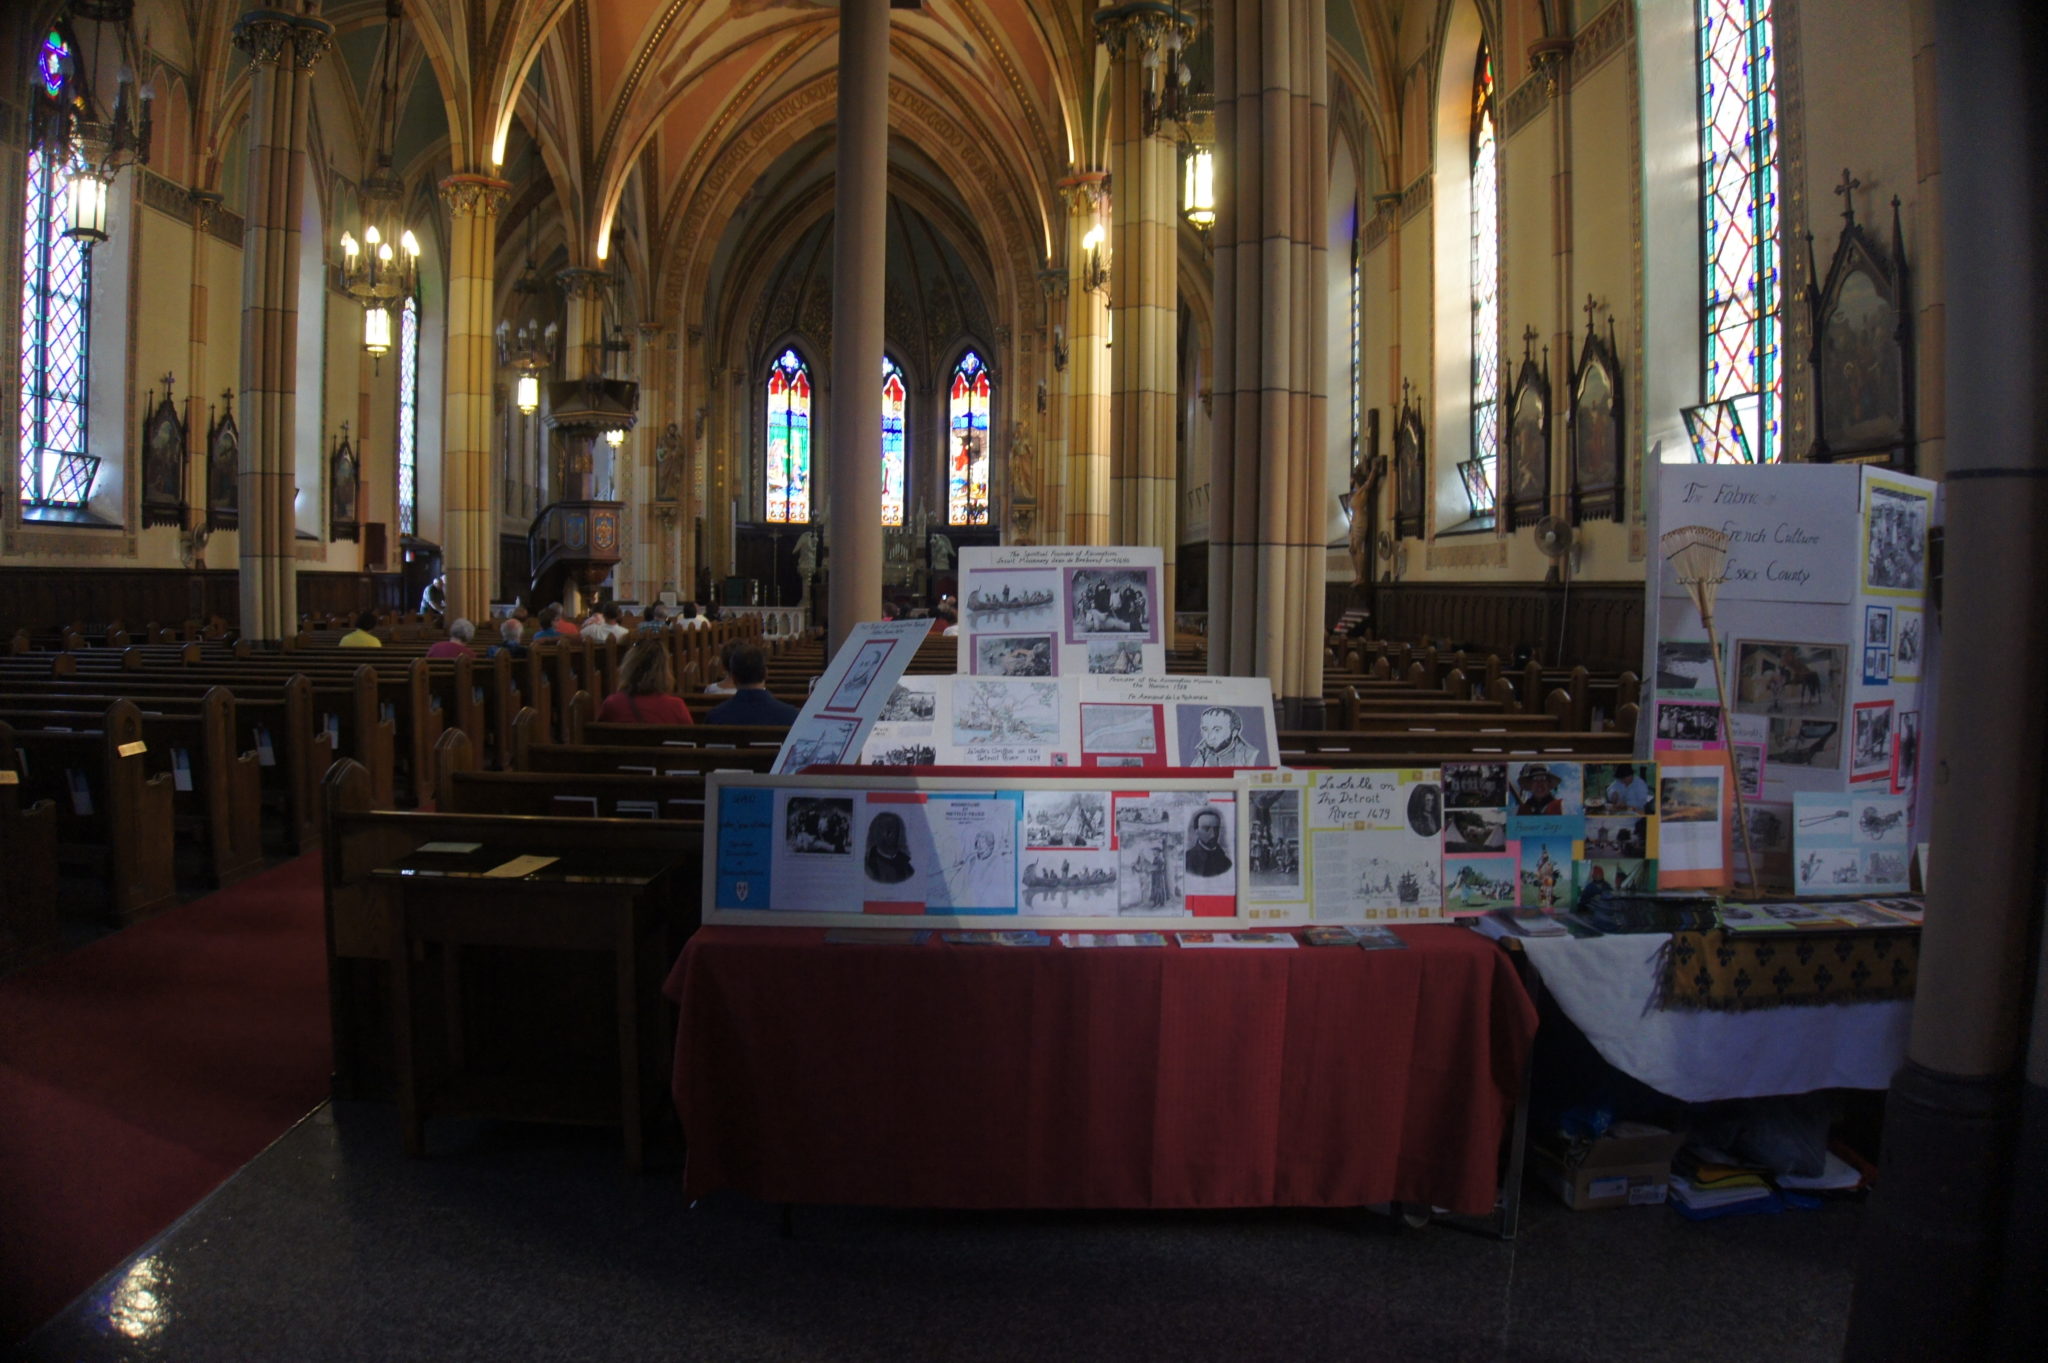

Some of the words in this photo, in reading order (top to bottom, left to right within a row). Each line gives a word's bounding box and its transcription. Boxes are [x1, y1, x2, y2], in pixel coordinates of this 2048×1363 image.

[1714, 483, 1760, 504] Fabric
[1774, 522, 1820, 545] Culture
[1722, 558, 1758, 581] Essex
[1766, 560, 1811, 586] County
[1380, 783, 1396, 791] on
[1318, 792, 1336, 805] The
[1339, 792, 1381, 804] Detroit
[1328, 806, 1361, 823] River
[1367, 808, 1391, 820] 1679
